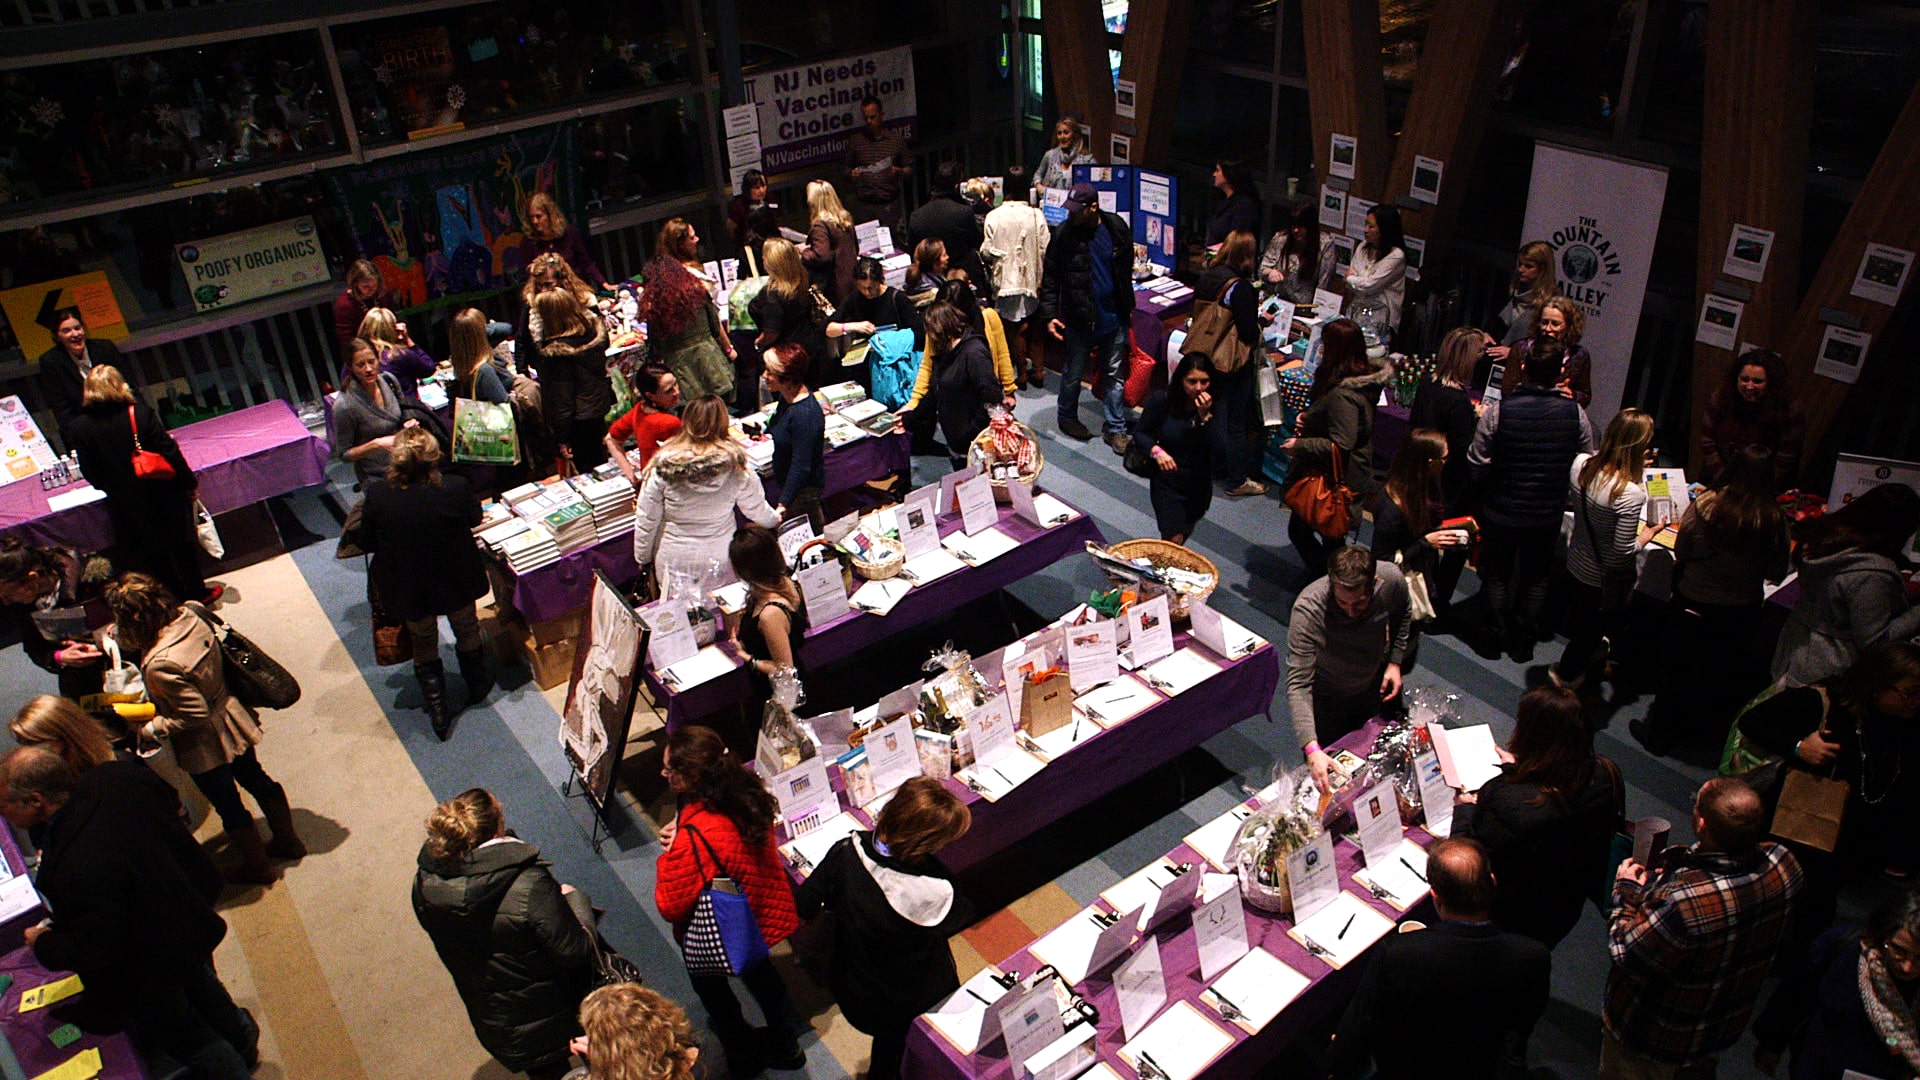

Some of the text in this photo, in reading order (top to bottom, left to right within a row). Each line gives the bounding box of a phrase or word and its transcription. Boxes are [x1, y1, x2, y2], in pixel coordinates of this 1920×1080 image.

[383, 46, 448, 71] BIRTH
[774, 58, 876, 94] NJ Needs
[776, 77, 905, 117] Vaccination
[779, 112, 853, 140] Choice
[1579, 216, 1597, 228] THE
[194, 255, 243, 281] POOFY
[245, 239, 316, 270] ORGANICS
[1557, 281, 1607, 307] ALLEY
